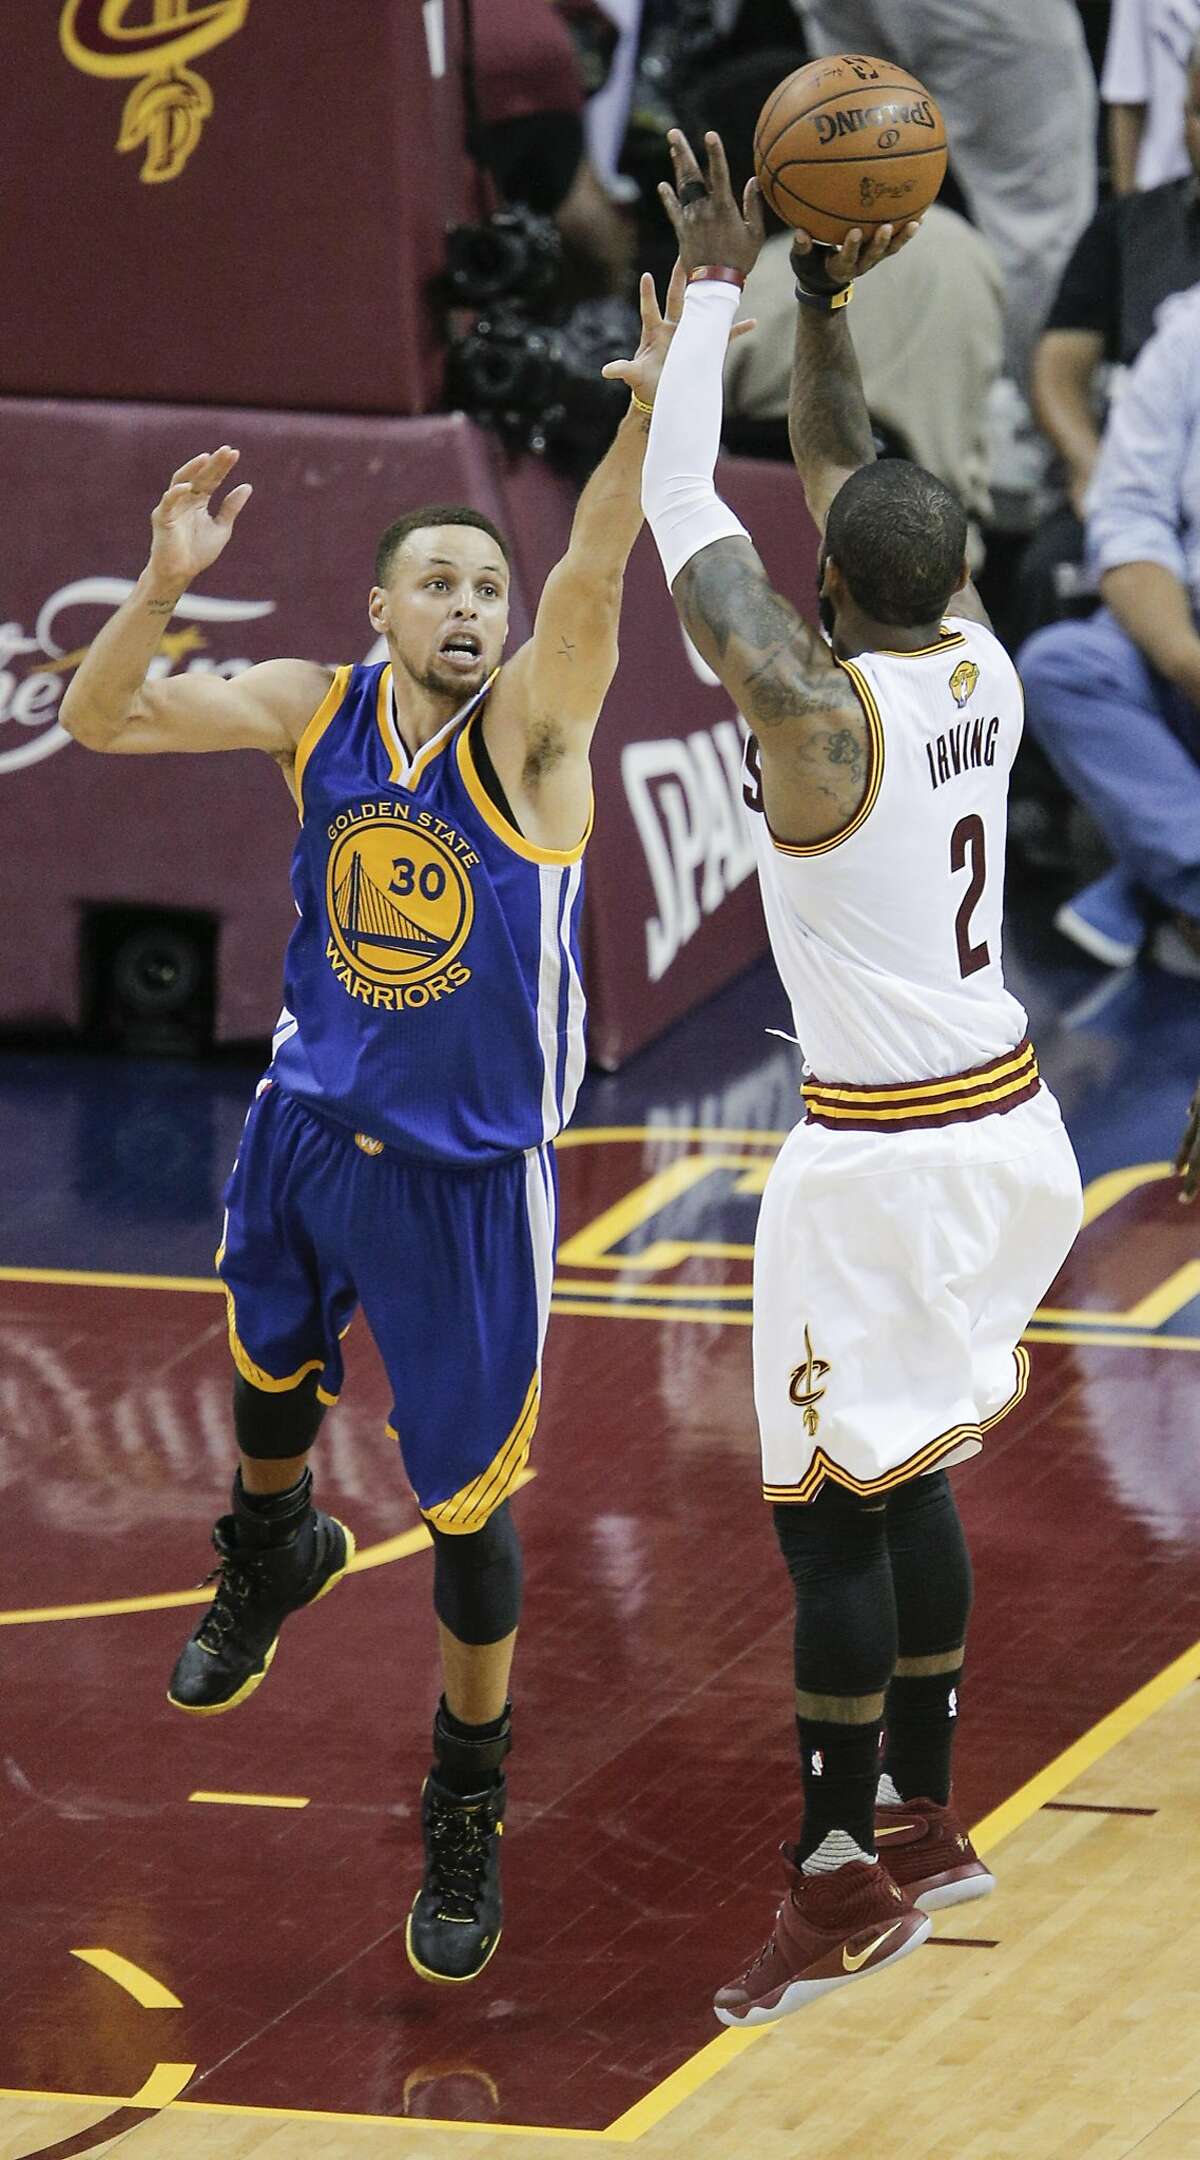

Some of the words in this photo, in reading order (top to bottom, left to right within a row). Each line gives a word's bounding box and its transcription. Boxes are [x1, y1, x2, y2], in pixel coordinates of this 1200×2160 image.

[814, 101, 935, 144] SPALDING
[926, 716, 999, 791] IRVING
[327, 802, 409, 841] GOLDEN
[417, 812, 480, 869] STATE
[388, 857, 446, 901] 30
[950, 813, 990, 979] 2
[326, 936, 472, 1010] WARRIORS
